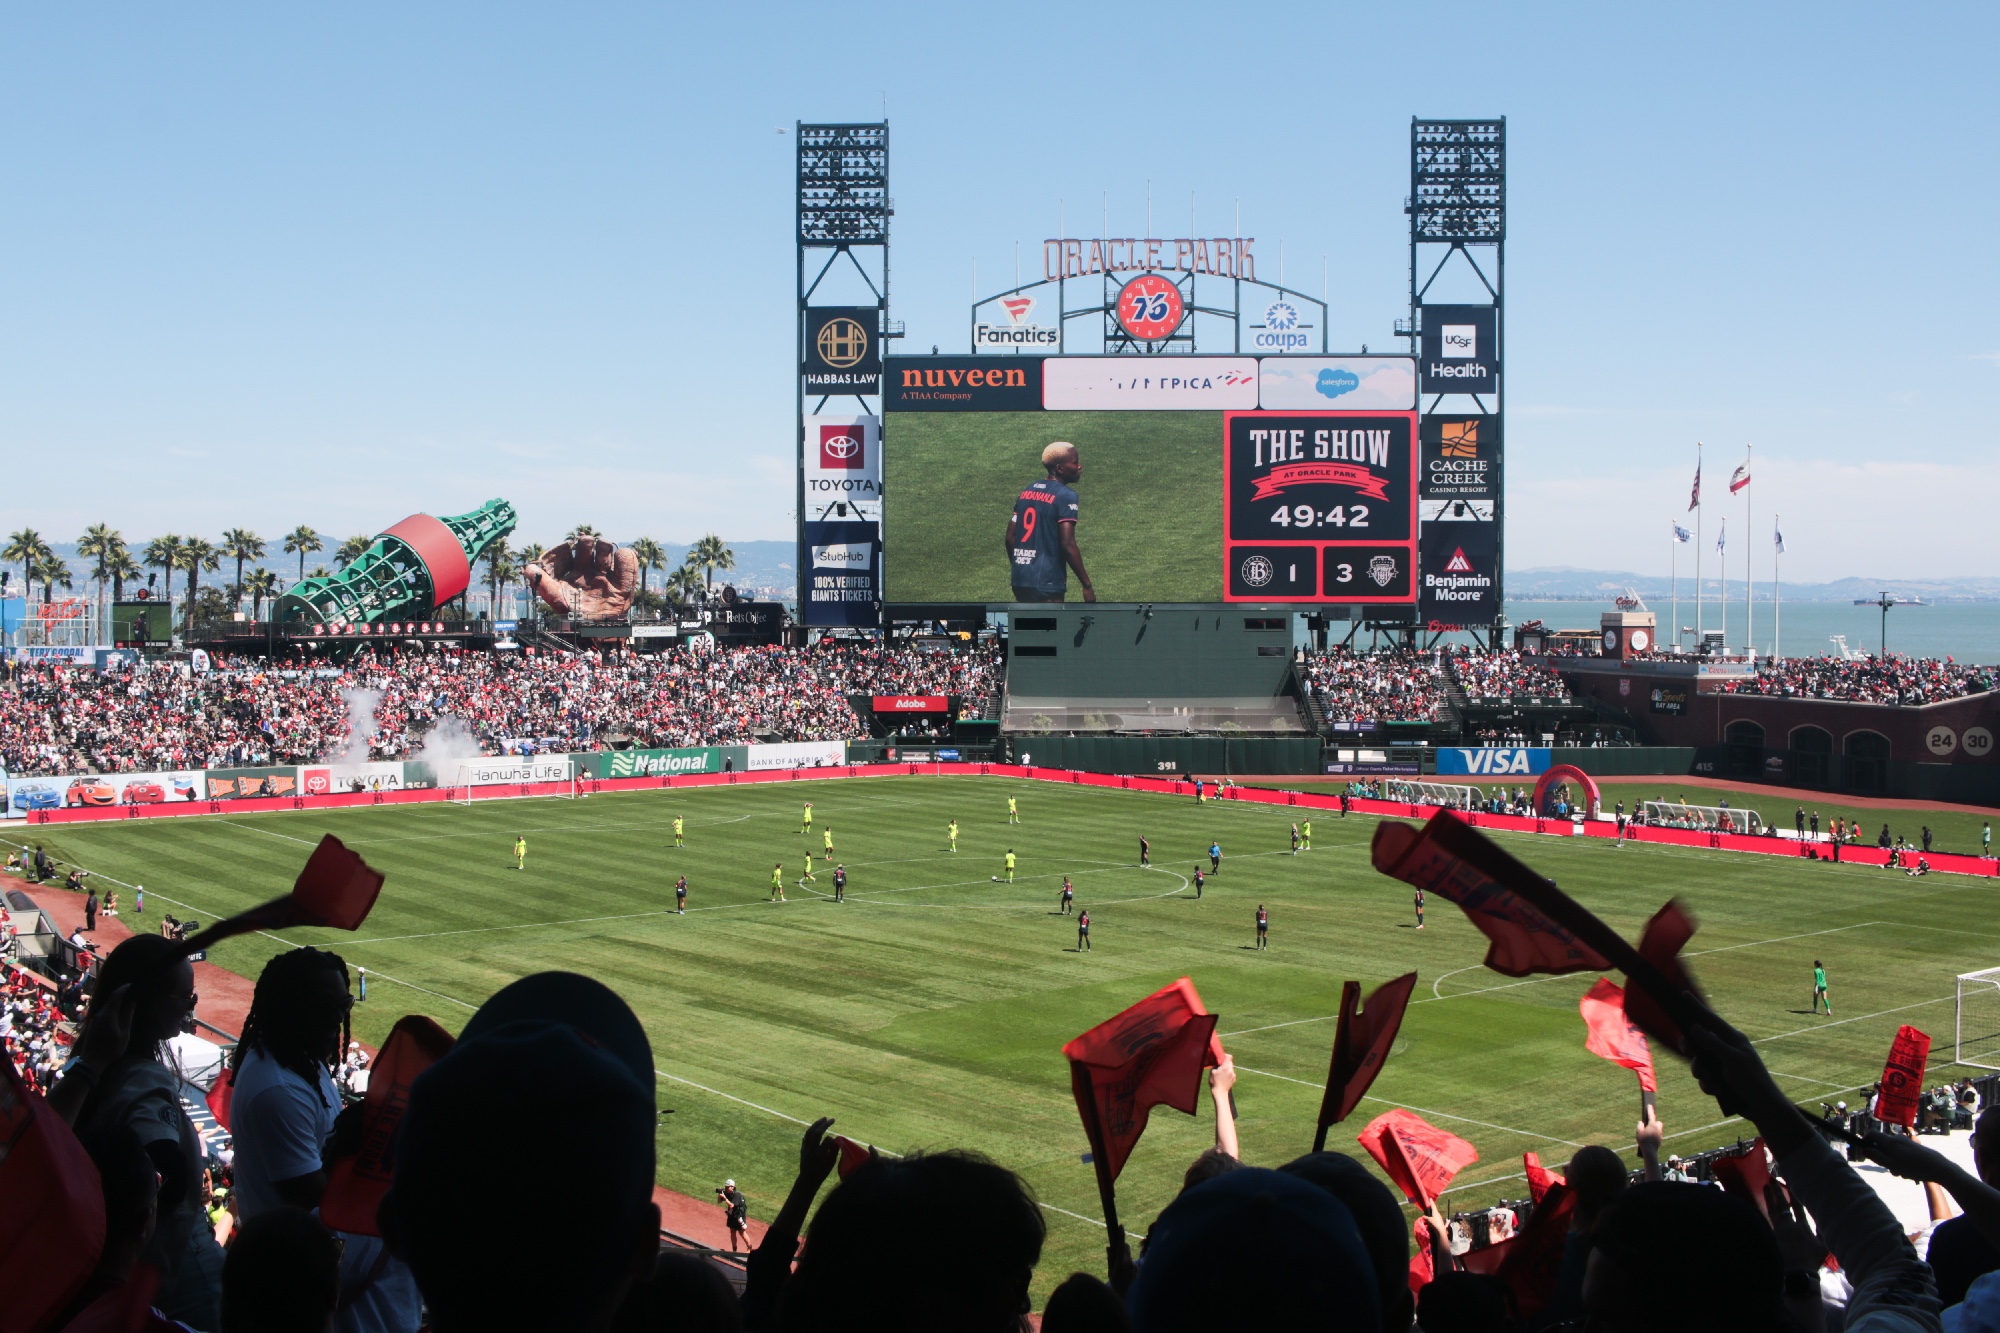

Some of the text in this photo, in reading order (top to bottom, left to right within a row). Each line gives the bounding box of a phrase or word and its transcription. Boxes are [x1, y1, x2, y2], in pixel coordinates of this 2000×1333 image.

[1044, 238, 1256, 282] ORACLE PARK
[1130, 292, 1170, 322] 76
[978, 326, 1058, 344] Fanatics
[1256, 333, 1308, 348] coupa
[1446, 335, 1472, 348] UCSF
[1431, 363, 1486, 378] Health
[808, 374, 876, 384] HABBAS LAW
[902, 368, 1026, 387] nuveen
[1321, 378, 1355, 388] salesforce
[933, 392, 972, 400] Company
[1250, 430, 1390, 468] THE SHOW
[1430, 460, 1488, 472] CACHE
[1334, 470, 1356, 478] PARK
[1432, 473, 1486, 484] CREEK
[810, 479, 875, 491] TOYOTA
[1270, 505, 1369, 527] 49:42
[1021, 506, 1036, 542] 9
[820, 552, 864, 561] StubHub
[1290, 564, 1296, 582] 1
[1336, 564, 1353, 582] 3
[814, 576, 870, 588] 100% VERIFIED
[1426, 574, 1490, 589] Benjamin
[812, 590, 872, 602] GIANTS TICKETS
[1436, 589, 1481, 601] Moore
[1616, 596, 1638, 606] Coors
[726, 610, 744, 623] Peet's
[746, 611, 767, 624] Coffee
[1428, 620, 1461, 632] Coors
[896, 700, 926, 708] Adobe
[1932, 734, 1952, 748] 24
[1968, 734, 1988, 748] 30
[634, 752, 707, 773] National
[788, 756, 825, 765] AMERICA
[1158, 762, 1176, 770] 391
[1458, 749, 1530, 774] VISA
[1696, 763, 1713, 771] 415
[470, 766, 562, 781] Hanwha Life
[337, 774, 398, 789] TOYOTA
[1438, 1169, 1447, 1181] VISA
